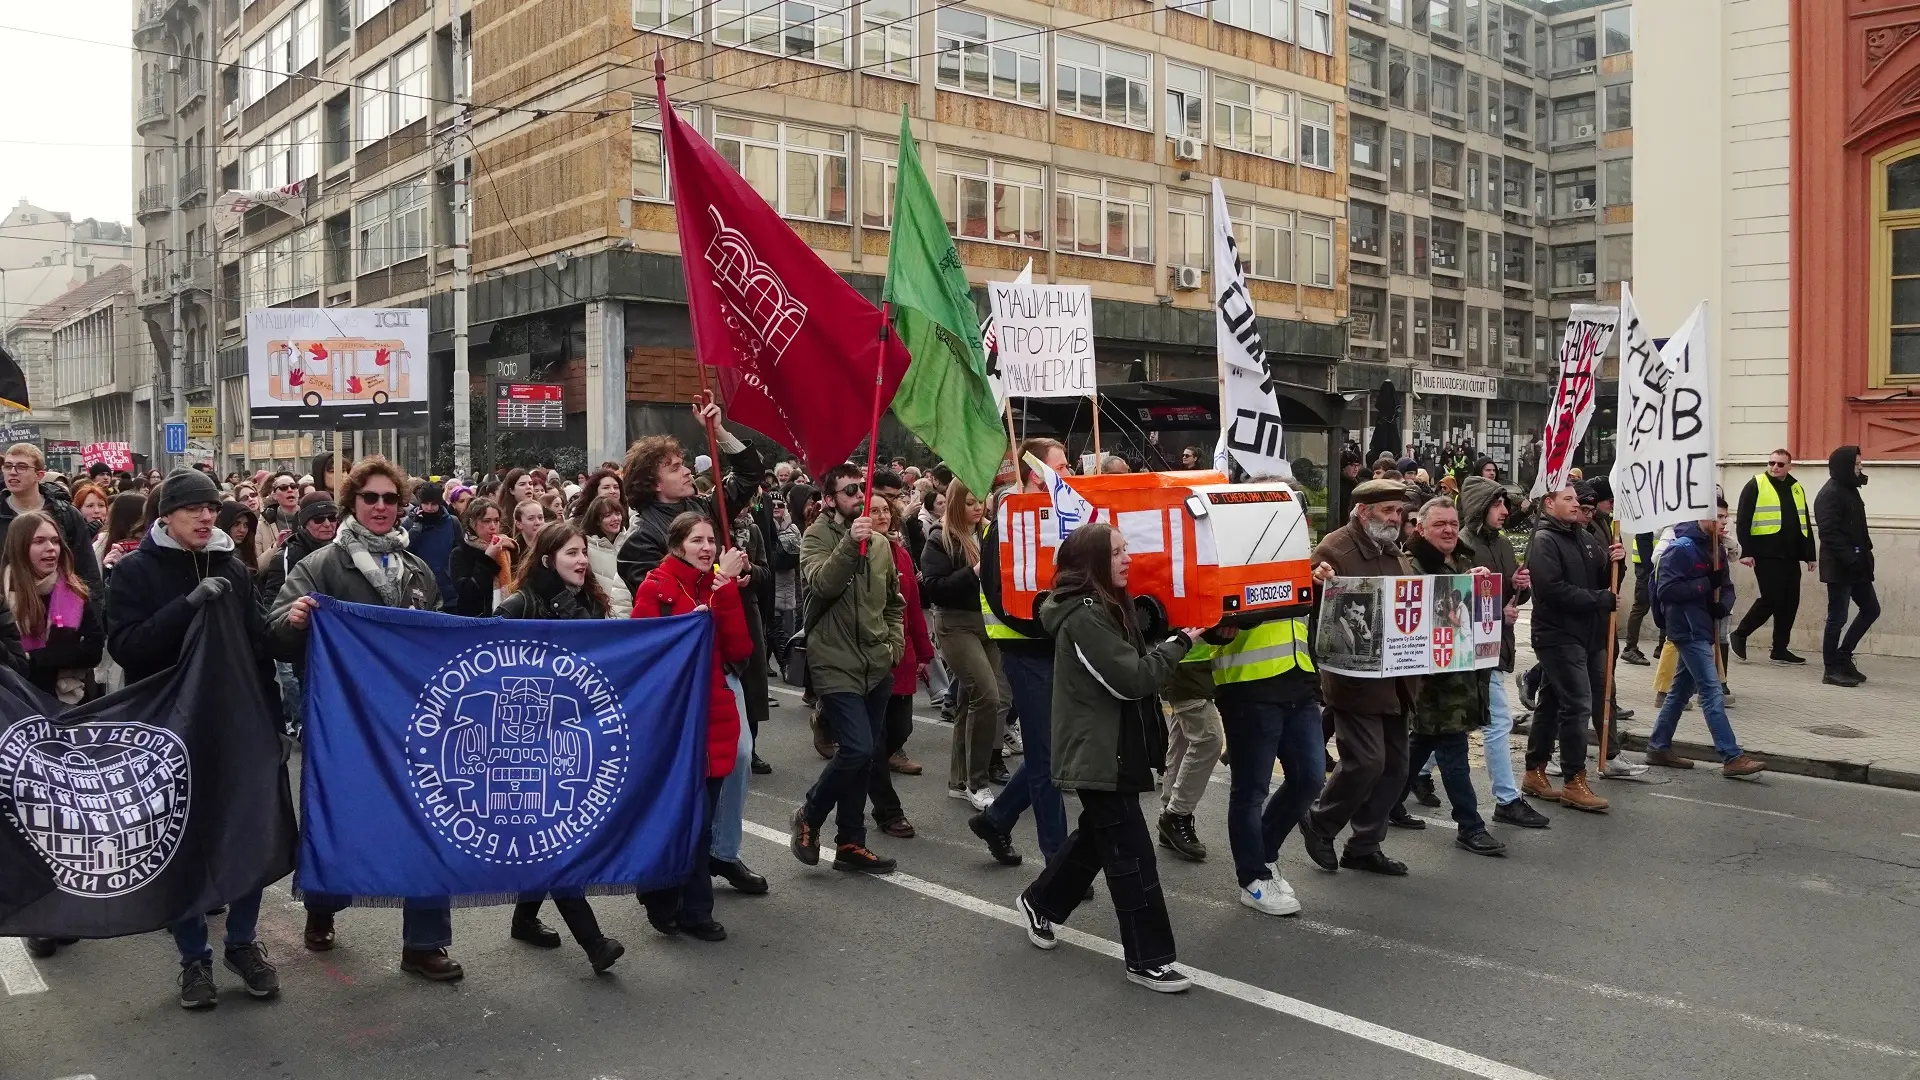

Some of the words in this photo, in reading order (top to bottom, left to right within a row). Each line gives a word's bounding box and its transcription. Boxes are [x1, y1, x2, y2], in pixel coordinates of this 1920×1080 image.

[996, 288, 1087, 318] МАШИНЦИ
[255, 312, 319, 330] МАШИНЦИ
[1002, 325, 1088, 355] ПРОТИВ
[497, 360, 518, 377] Plato
[1005, 357, 1094, 393] МАШИНЕРИЈЕ
[1423, 375, 1436, 389] NIJE
[1436, 377, 1468, 391] FILOZOFSKI
[1209, 493, 1219, 503] 15
[1221, 492, 1263, 503] ГЕНЕРАЛНИ
[1041, 510, 1048, 519] 15
[415, 645, 547, 738] ФИЛОЛОШКИ
[552, 655, 623, 735] ФАКУЛТЕТ
[88, 728, 101, 744] У
[108, 728, 188, 781] БЕОГРАДУ
[414, 762, 500, 855] БЕОГРАДУ
[529, 757, 621, 856] УНИВЕРЗИТЕТ
[107, 793, 187, 890] ФАКУЛТЕТ
[507, 836, 519, 858] У
